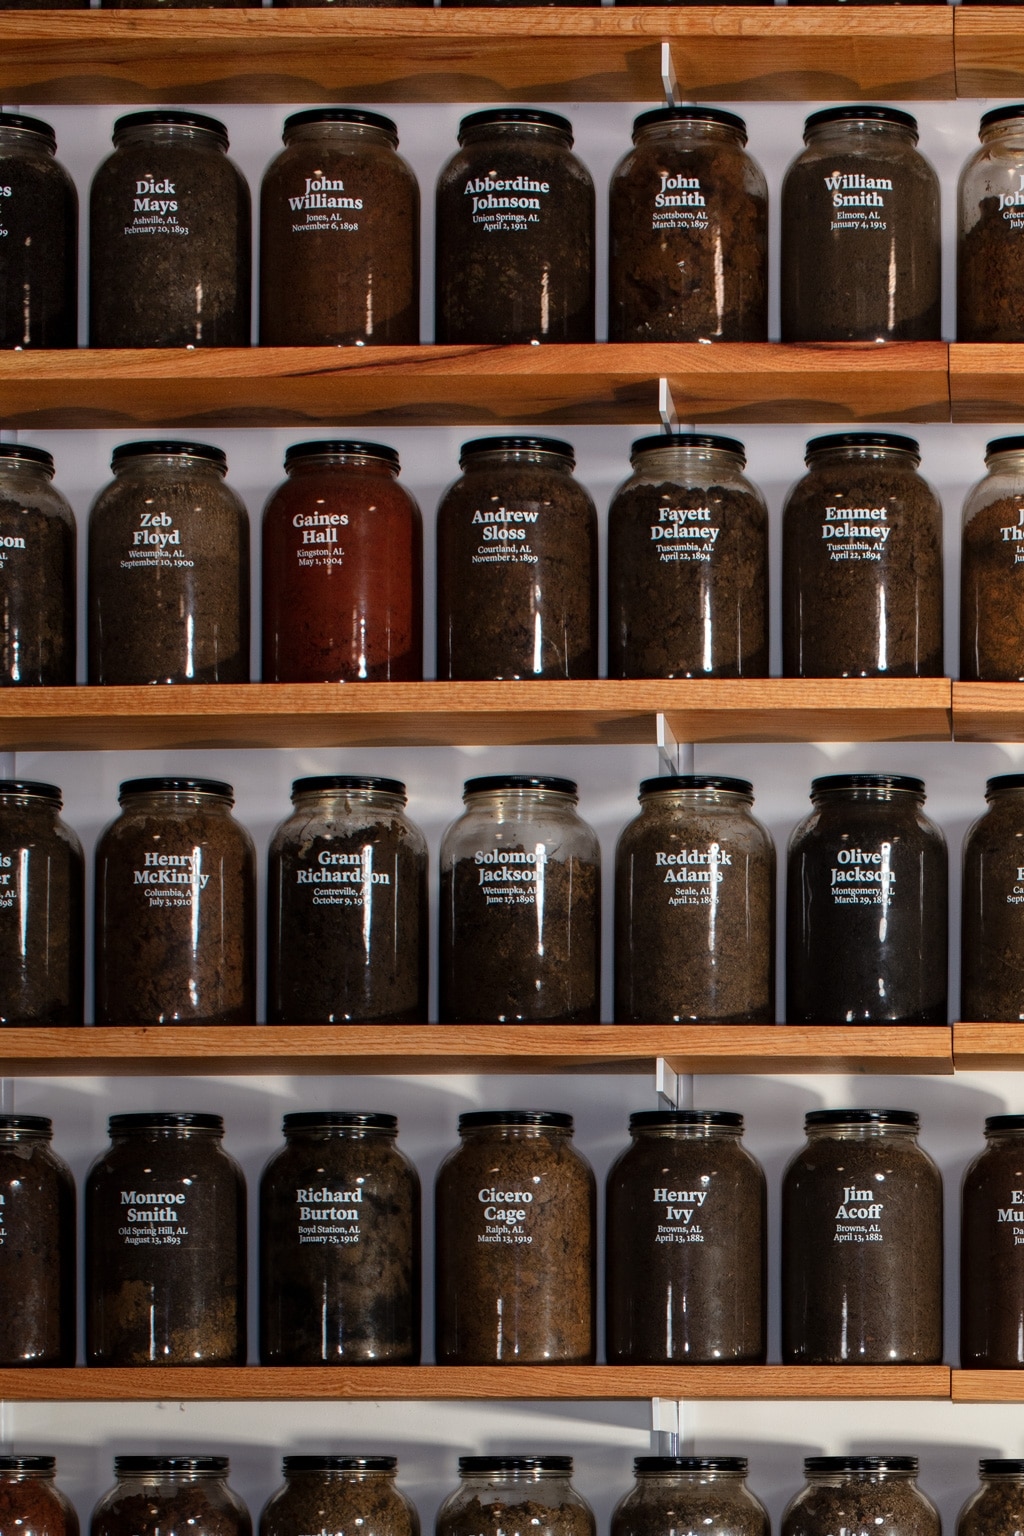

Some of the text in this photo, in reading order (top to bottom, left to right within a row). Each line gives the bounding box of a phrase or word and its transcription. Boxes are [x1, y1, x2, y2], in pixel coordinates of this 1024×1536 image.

[136, 179, 176, 194] Dick
[824, 174, 893, 190] William
[833, 191, 884, 207] Smith
[133, 198, 178, 215] Mays
[133, 216, 178, 225] Ashville, AL
[837, 211, 880, 220] Elmore, AL
[124, 225, 189, 235] February 20, 1893
[831, 221, 886, 230] January 4, 1915
[293, 511, 348, 528] Gaines
[825, 507, 887, 521] Emmet
[302, 528, 338, 544] Hall
[822, 523, 890, 542] Delaney
[297, 547, 344, 558] Kingston, AL
[827, 542, 885, 551] Tuscumbia, AL
[830, 551, 881, 561] April 22, 1894
[299, 558, 343, 567] May 1, 1904
[478, 1187, 533, 1202] Cicero
[484, 1206, 526, 1225] Cage
[485, 1226, 511, 1234] Ralph,
[478, 1234, 502, 1242] March
